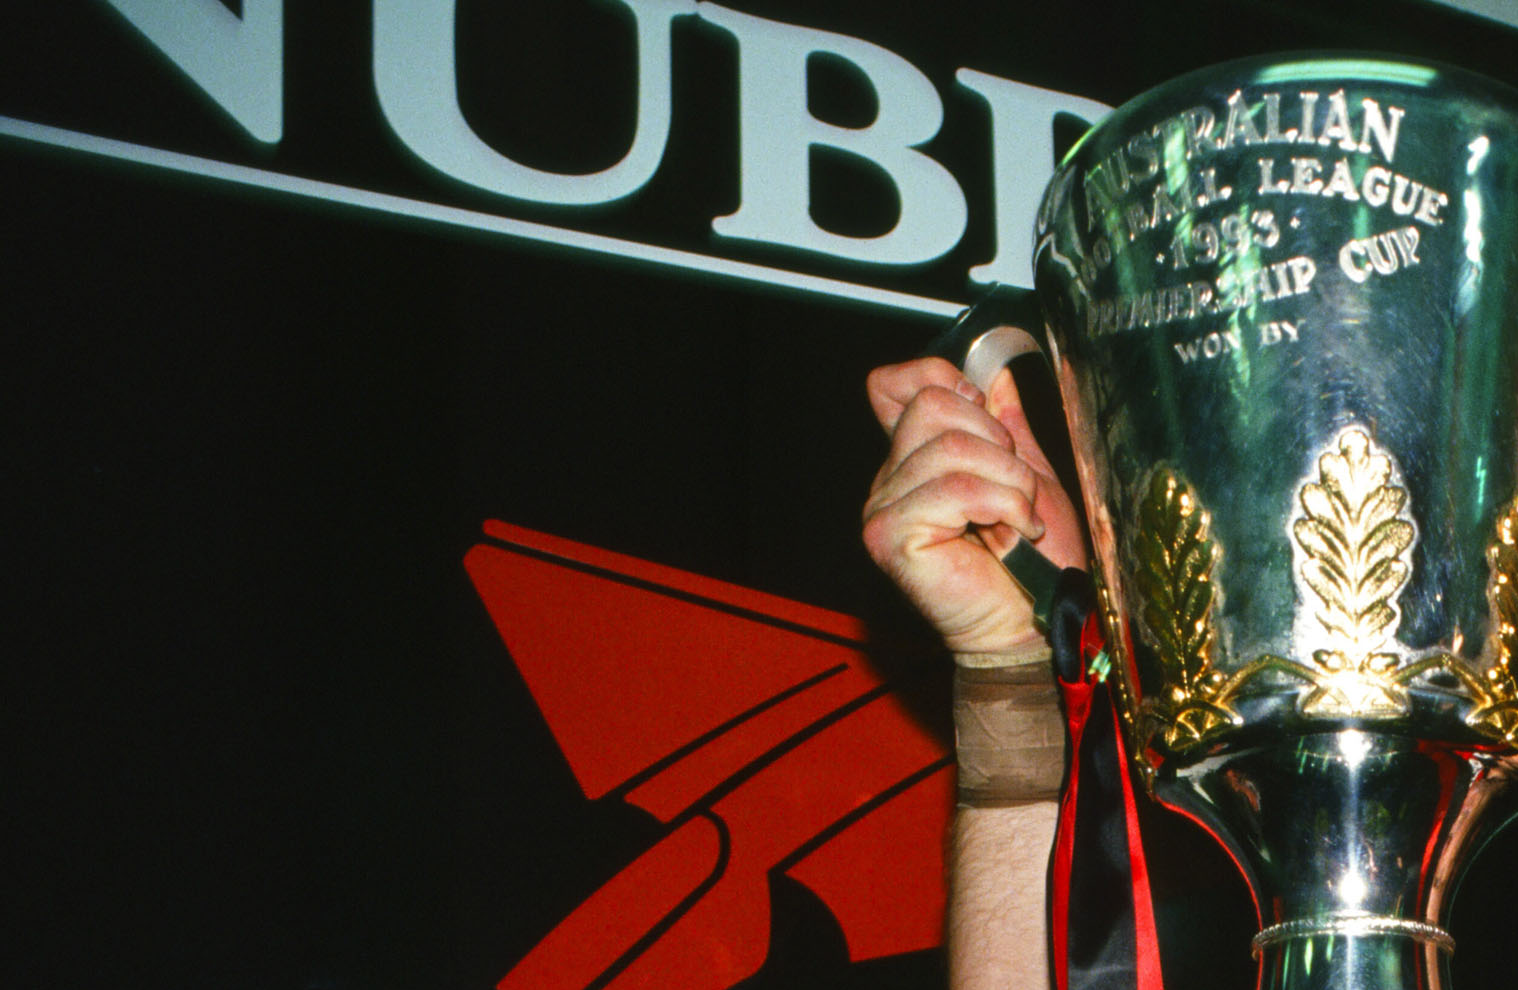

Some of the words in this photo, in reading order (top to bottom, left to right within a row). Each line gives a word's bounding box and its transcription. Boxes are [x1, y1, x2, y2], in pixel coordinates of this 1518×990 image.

[1258, 157, 1448, 226] LEAGUE
[1338, 226, 1421, 283] CUP
[1174, 330, 1241, 365] WON
[1258, 319, 1305, 348] BY
